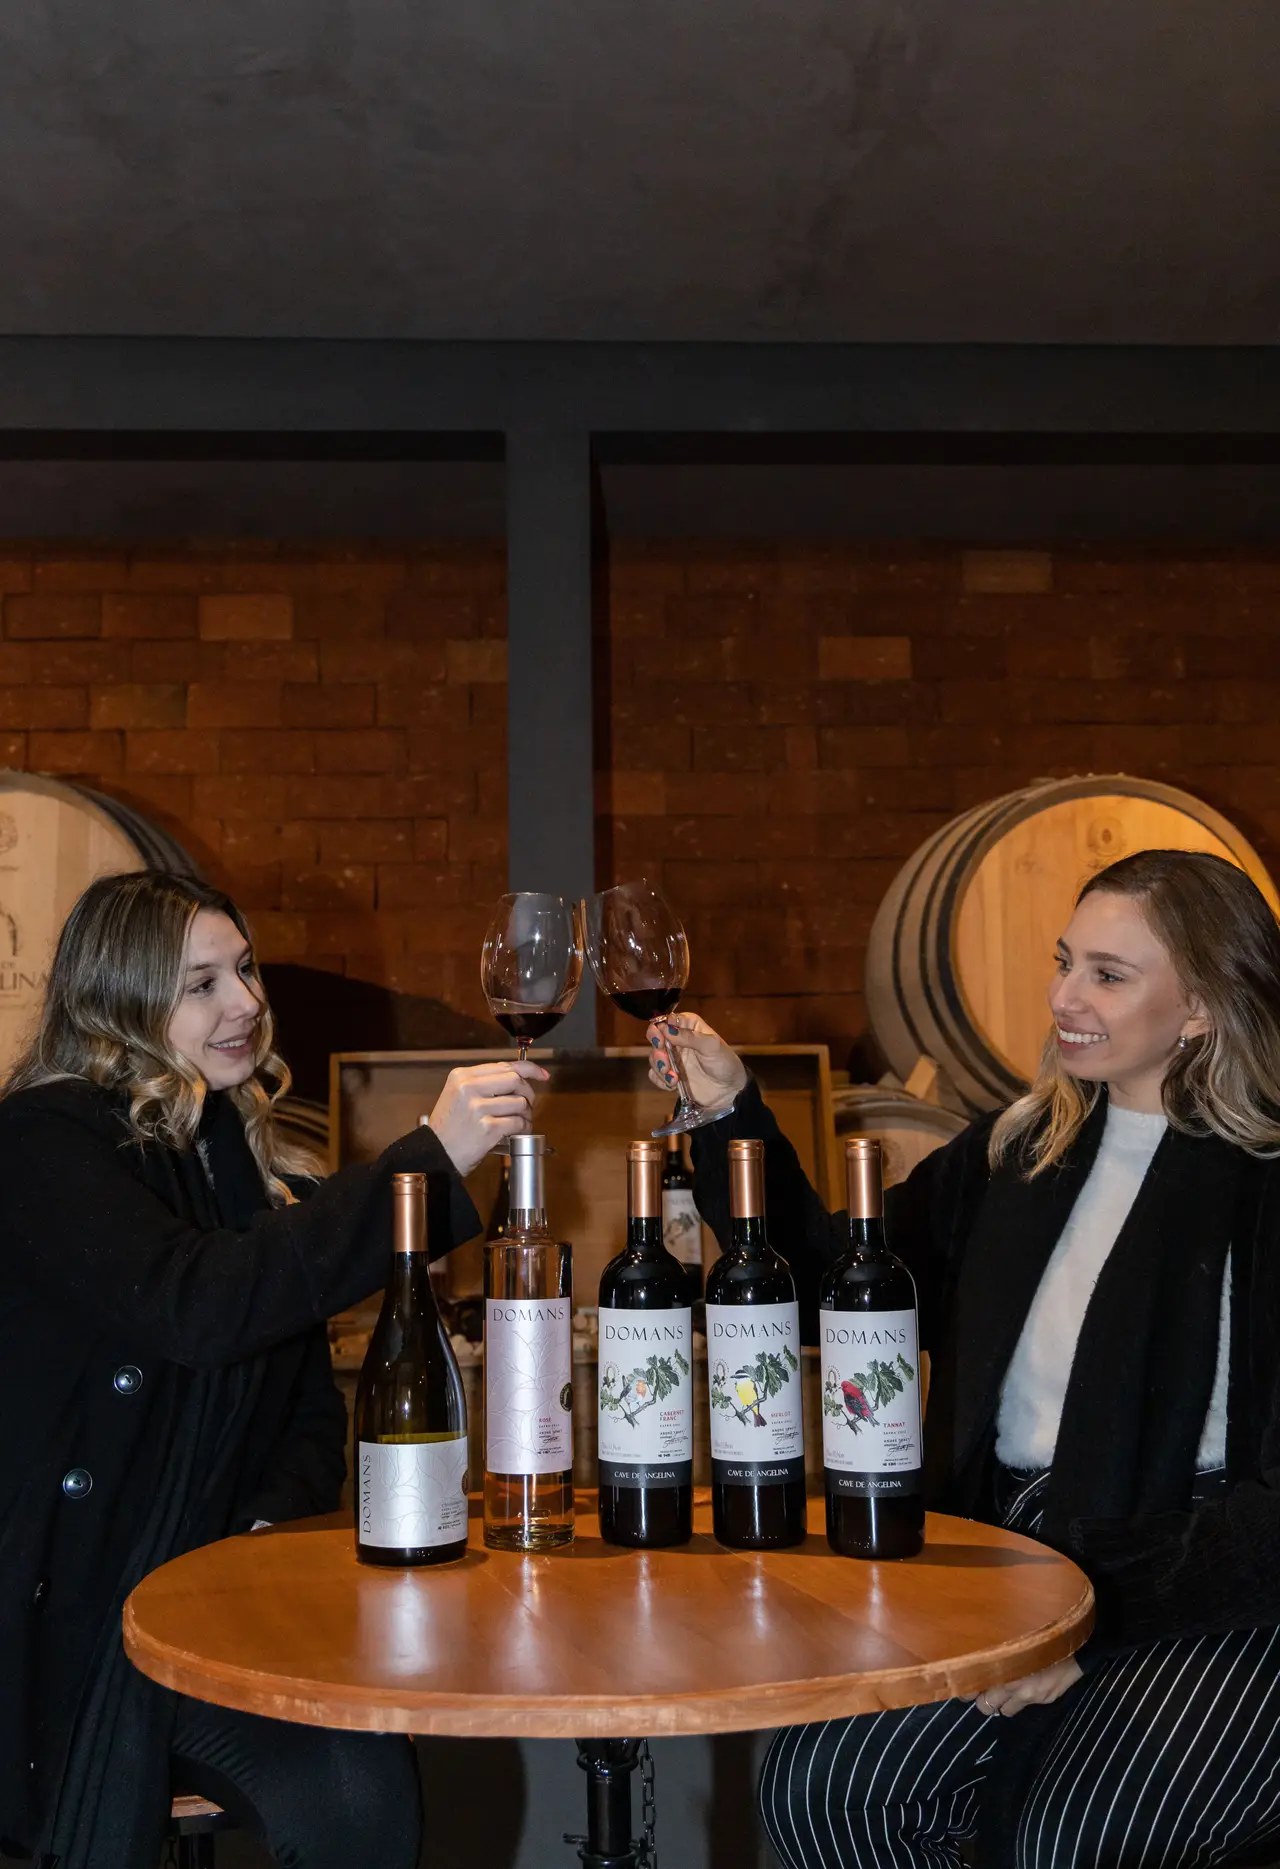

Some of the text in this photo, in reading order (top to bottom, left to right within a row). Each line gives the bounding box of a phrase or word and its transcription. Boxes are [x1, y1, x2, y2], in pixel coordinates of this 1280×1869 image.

[493, 1307, 565, 1322] DOMANS
[605, 1325, 684, 1341] DOMANS
[713, 1320, 792, 1338] DOMANS
[826, 1328, 906, 1345] DOMANS
[659, 1409, 685, 1417] CABERNET
[882, 1421, 905, 1429] TANNAT
[614, 1470, 630, 1479] CAVE
[644, 1471, 676, 1479] ANGELINA
[727, 1469, 744, 1477] CAVE
[756, 1468, 789, 1477] ANGELINA
[838, 1479, 854, 1487] CAVE
[867, 1480, 902, 1488] ANGELINA
[362, 1454, 372, 1534] DOMANS
